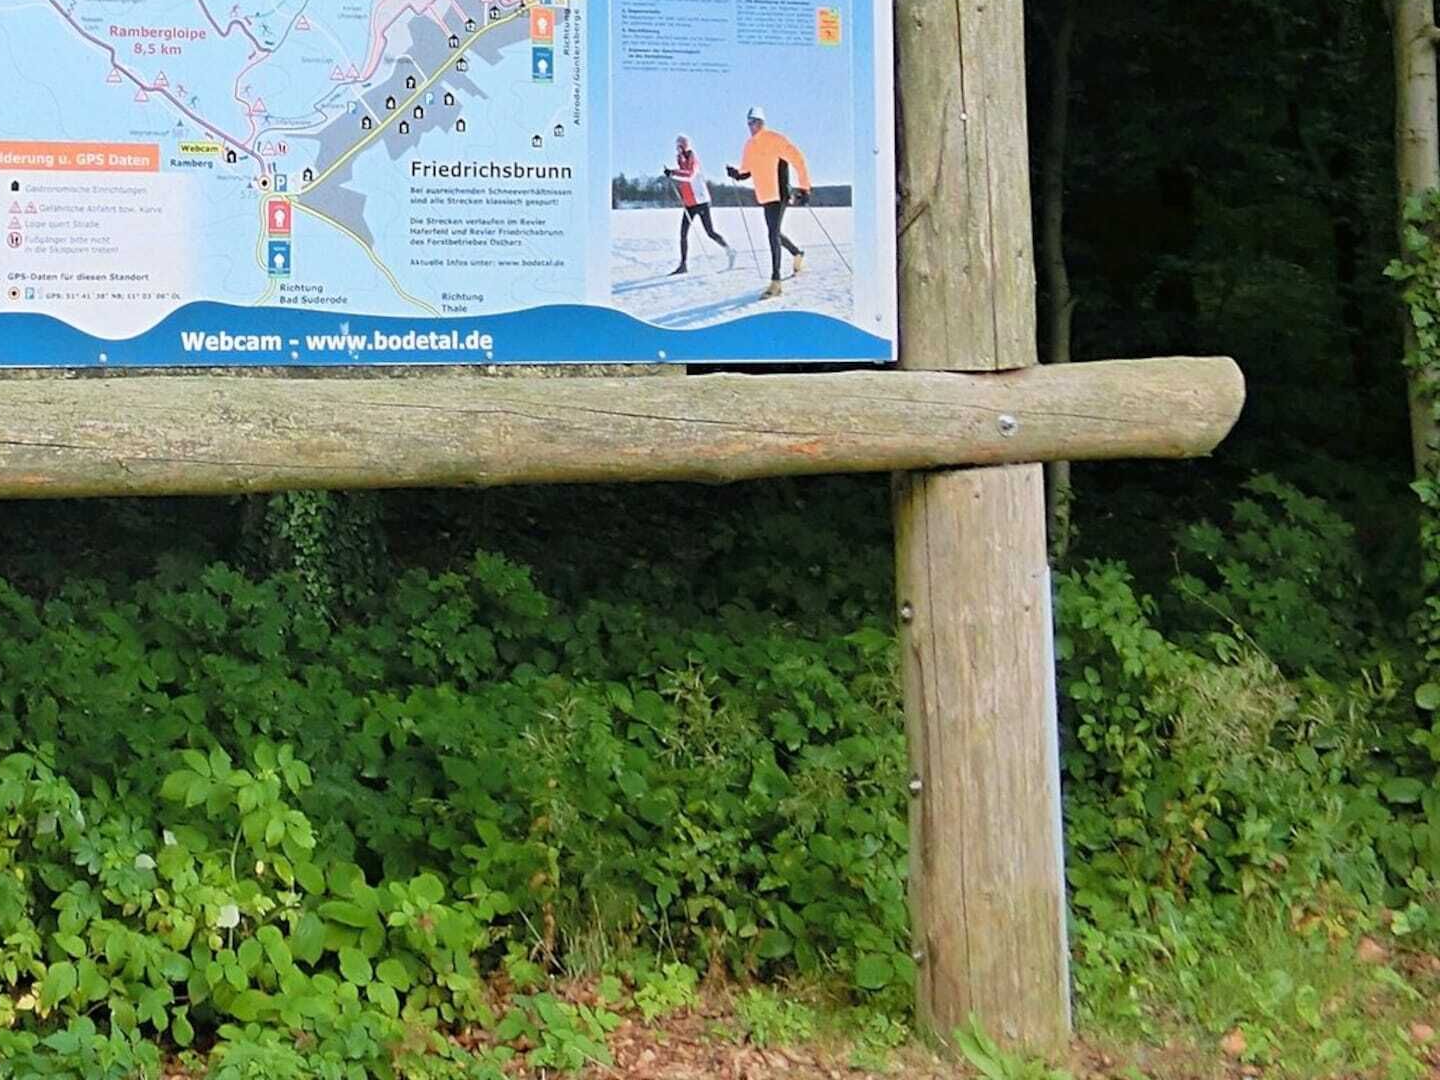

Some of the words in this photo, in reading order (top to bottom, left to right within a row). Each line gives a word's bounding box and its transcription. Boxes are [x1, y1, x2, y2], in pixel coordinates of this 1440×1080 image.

[109, 25, 207, 40] Rambergloipe
[563, 8, 571, 56] Richtung
[133, 42, 156, 56] 8,5
[161, 44, 182, 55] km
[181, 145, 219, 153] Webcam
[58, 153, 71, 165] u.
[75, 153, 105, 166] GPS
[110, 153, 150, 167] Daten
[170, 159, 213, 169] Ramberg
[411, 161, 572, 179] Friedrichsbrunn
[7, 273, 58, 281] GPS-Daten
[60, 272, 74, 280] für
[76, 273, 107, 281] diesen
[109, 273, 150, 281] Standort
[280, 282, 324, 295] Richtung
[279, 295, 298, 304] Bad
[301, 294, 348, 305] Suderode
[441, 292, 484, 304] Richtung
[441, 303, 468, 313] Thale
[181, 331, 282, 351] Webcam
[306, 331, 493, 351] www.bodetal.de
